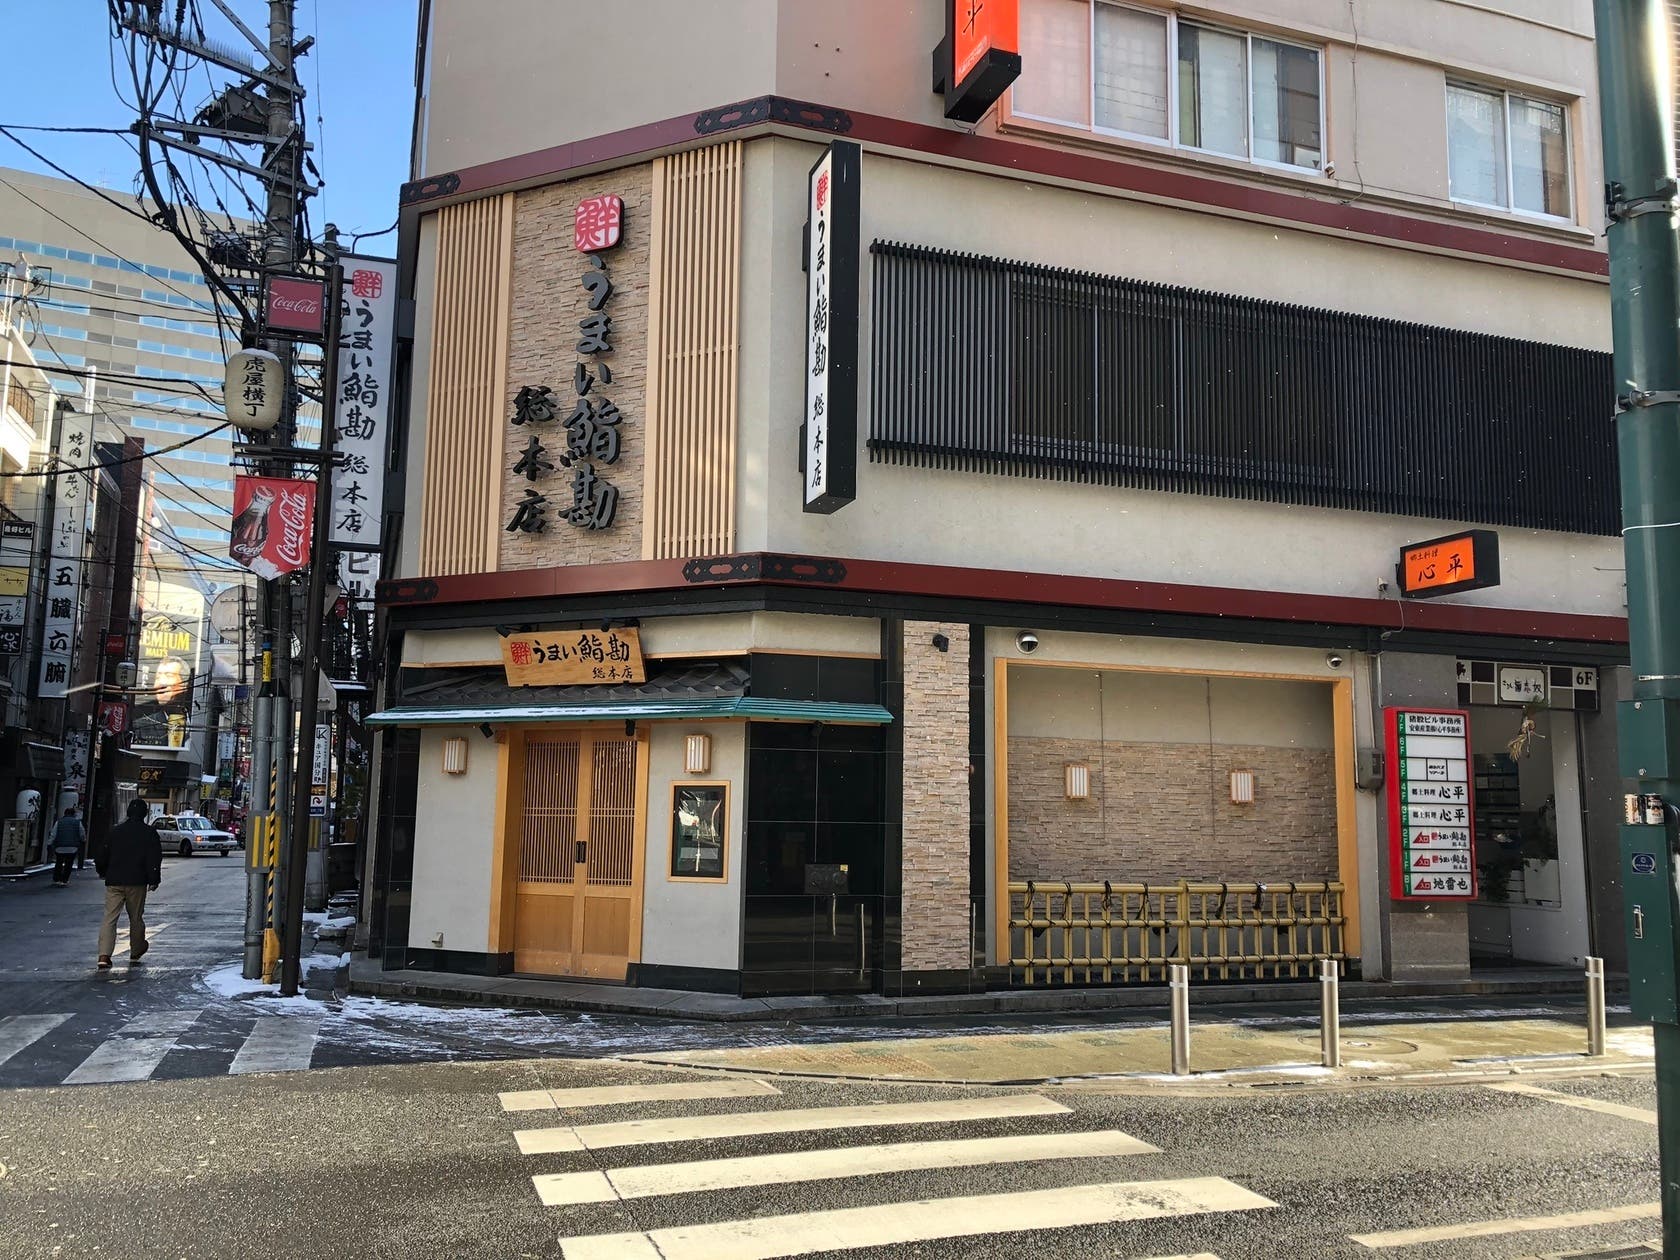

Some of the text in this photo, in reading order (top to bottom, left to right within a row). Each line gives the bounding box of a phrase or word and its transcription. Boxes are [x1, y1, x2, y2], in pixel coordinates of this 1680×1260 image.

[272, 295, 317, 315] Coca-Cola
[812, 211, 828, 377] うまい鮨勘
[241, 356, 267, 417] 虎屋横丁
[339, 300, 380, 441] うまい鮨勘
[559, 254, 622, 531] うまい鮨勘
[506, 384, 556, 533] 総本店
[811, 393, 824, 488] 総本店
[276, 488, 307, 565] Coca-Cola
[336, 453, 370, 534] 総本店
[1418, 553, 1464, 582] 心平
[44, 565, 74, 684] 五臓六腑
[532, 633, 630, 663] うまい鮨勘
[592, 666, 633, 680] 総本店
[1575, 671, 1593, 686] 6F
[1439, 786, 1465, 799] 心平
[1440, 808, 1466, 822] 心平
